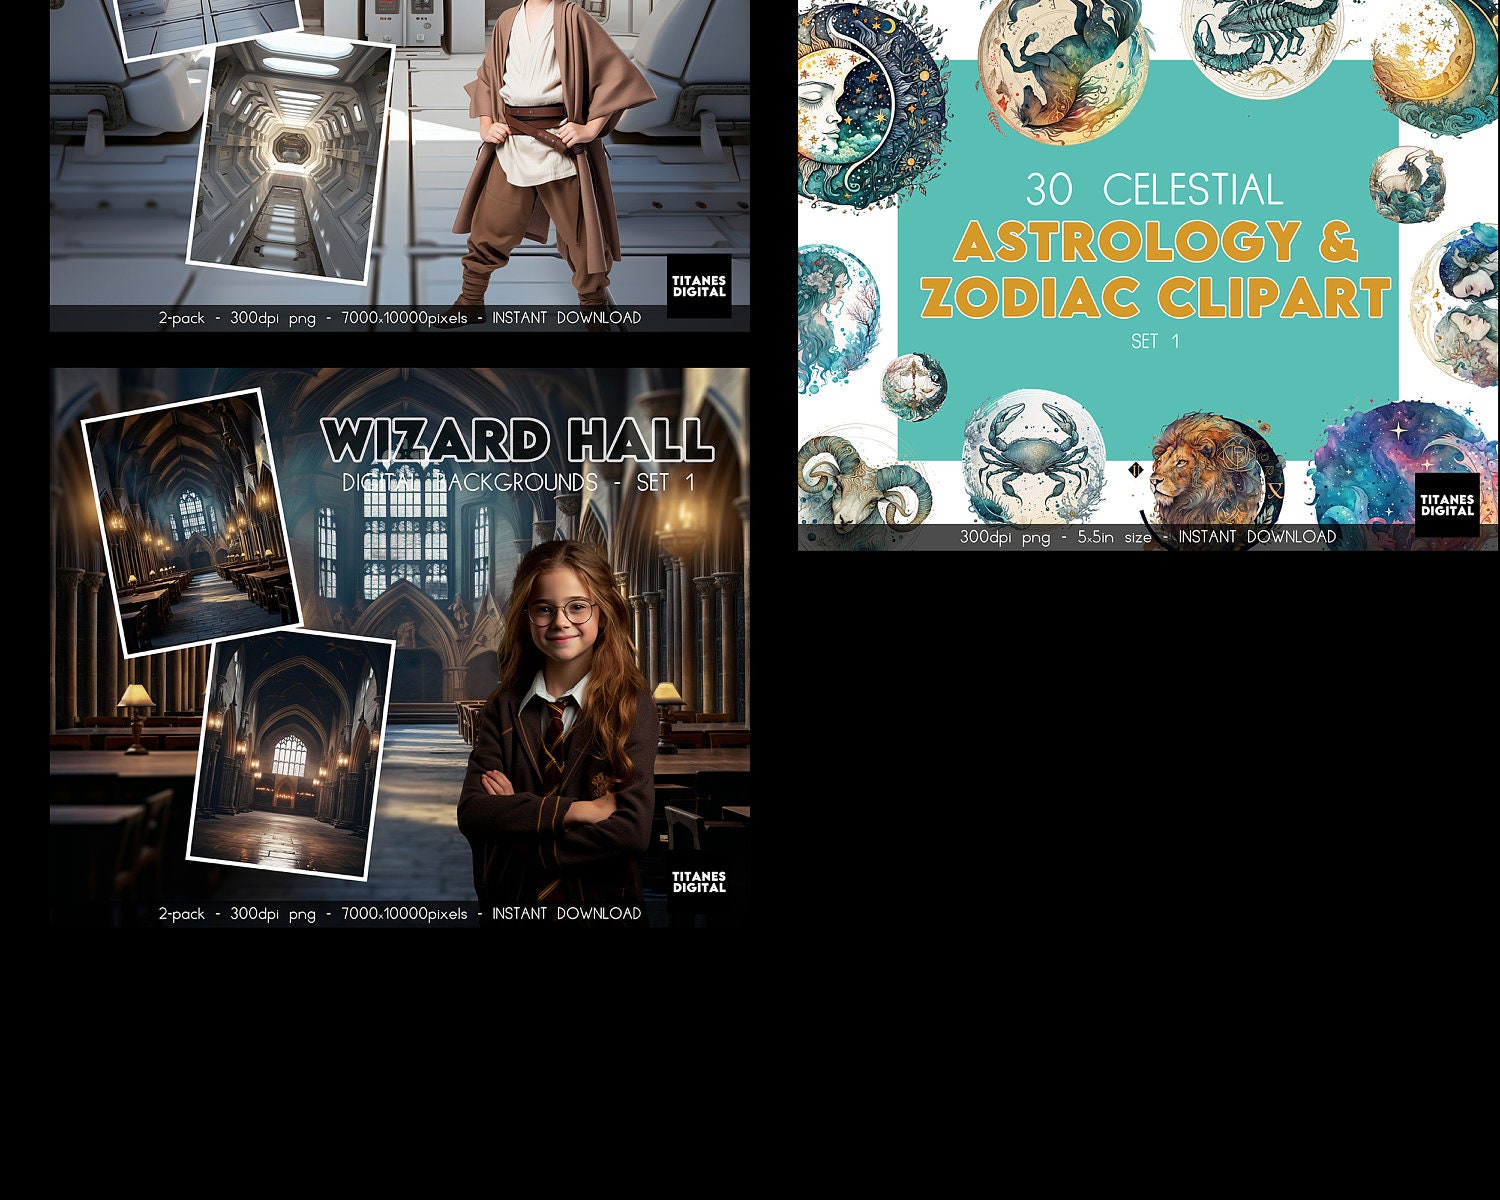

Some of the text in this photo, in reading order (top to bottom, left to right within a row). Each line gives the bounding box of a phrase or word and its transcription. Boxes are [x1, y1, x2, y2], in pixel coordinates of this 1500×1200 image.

[1026, 172, 1284, 206] 30 CELESTIAL
[953, 219, 1359, 263] ASTROLOGY &
[671, 275, 726, 286] TITANES
[672, 286, 727, 297] DIGITAL
[920, 275, 1392, 319] ZODIAC CLIPART
[158, 310, 205, 328] 2-pack
[230, 310, 279, 328] 300dpi
[289, 315, 316, 328] png
[492, 310, 548, 324] INSTANT
[557, 310, 642, 324] DOWNLOAD
[1132, 333, 1179, 348] SET 1
[319, 416, 716, 464] WIZARD HALL
[343, 473, 695, 492] DIGITAL BACKGROUNDS SET 1
[1420, 494, 1475, 505] TITANES
[1421, 505, 1476, 516] DIGITAL
[960, 529, 1012, 548] 300dpi
[1022, 533, 1051, 548] png
[1124, 532, 1152, 544] size
[1179, 529, 1237, 544] INSTANT
[1247, 529, 1337, 544] DOWNLOAD
[671, 871, 726, 882] TITANES
[672, 882, 727, 893] DIGITAL
[159, 906, 205, 924] 2-pack
[230, 906, 279, 924] 300dpi
[289, 910, 316, 924] png
[492, 906, 548, 920] INSTANT
[557, 906, 642, 920] DOWNLOAD
